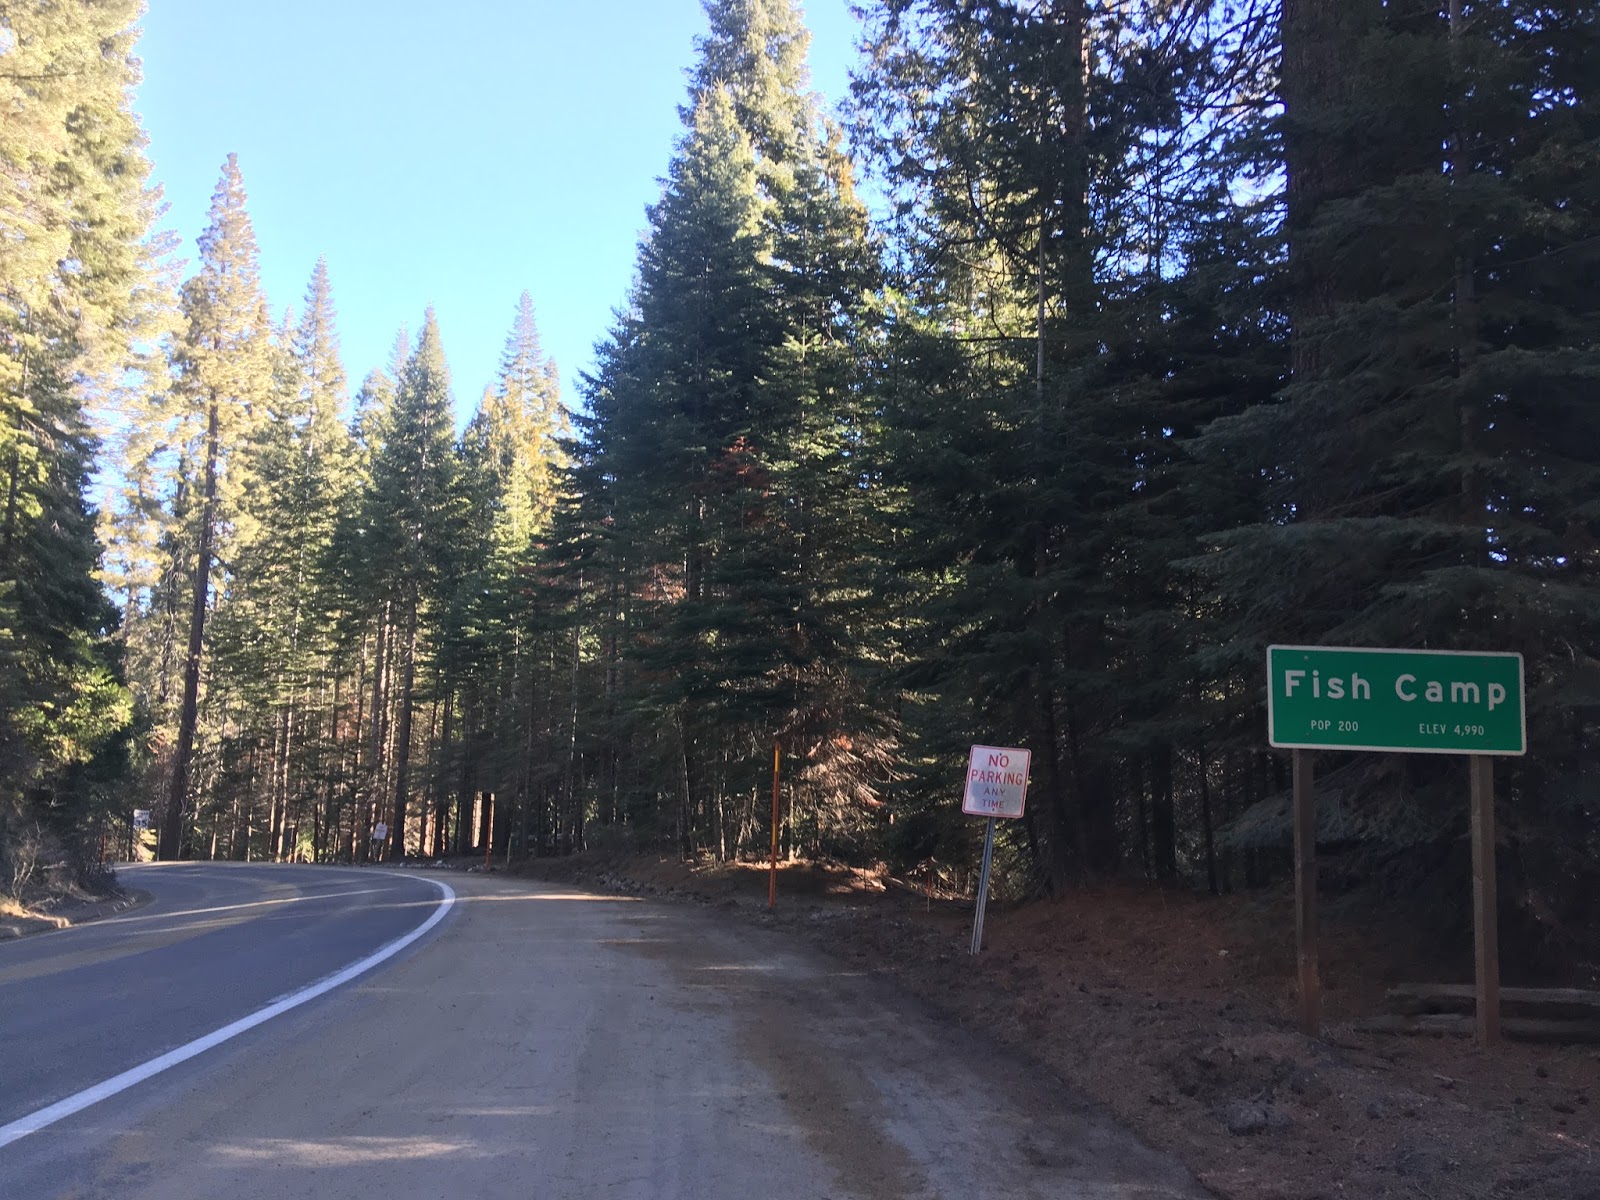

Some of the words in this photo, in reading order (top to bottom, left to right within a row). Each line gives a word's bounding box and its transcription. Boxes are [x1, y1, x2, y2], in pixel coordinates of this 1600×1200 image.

[1285, 669, 1371, 700] Fish
[1395, 673, 1507, 711] Camp
[1310, 720, 1331, 731] POP
[1338, 720, 1359, 732] 200
[1419, 723, 1446, 735] ELEV
[1454, 724, 1485, 736] 4,990
[988, 754, 1009, 768] NO
[970, 769, 1023, 786] PARKING
[983, 787, 1006, 797] ANY
[982, 799, 1005, 809] TIME
